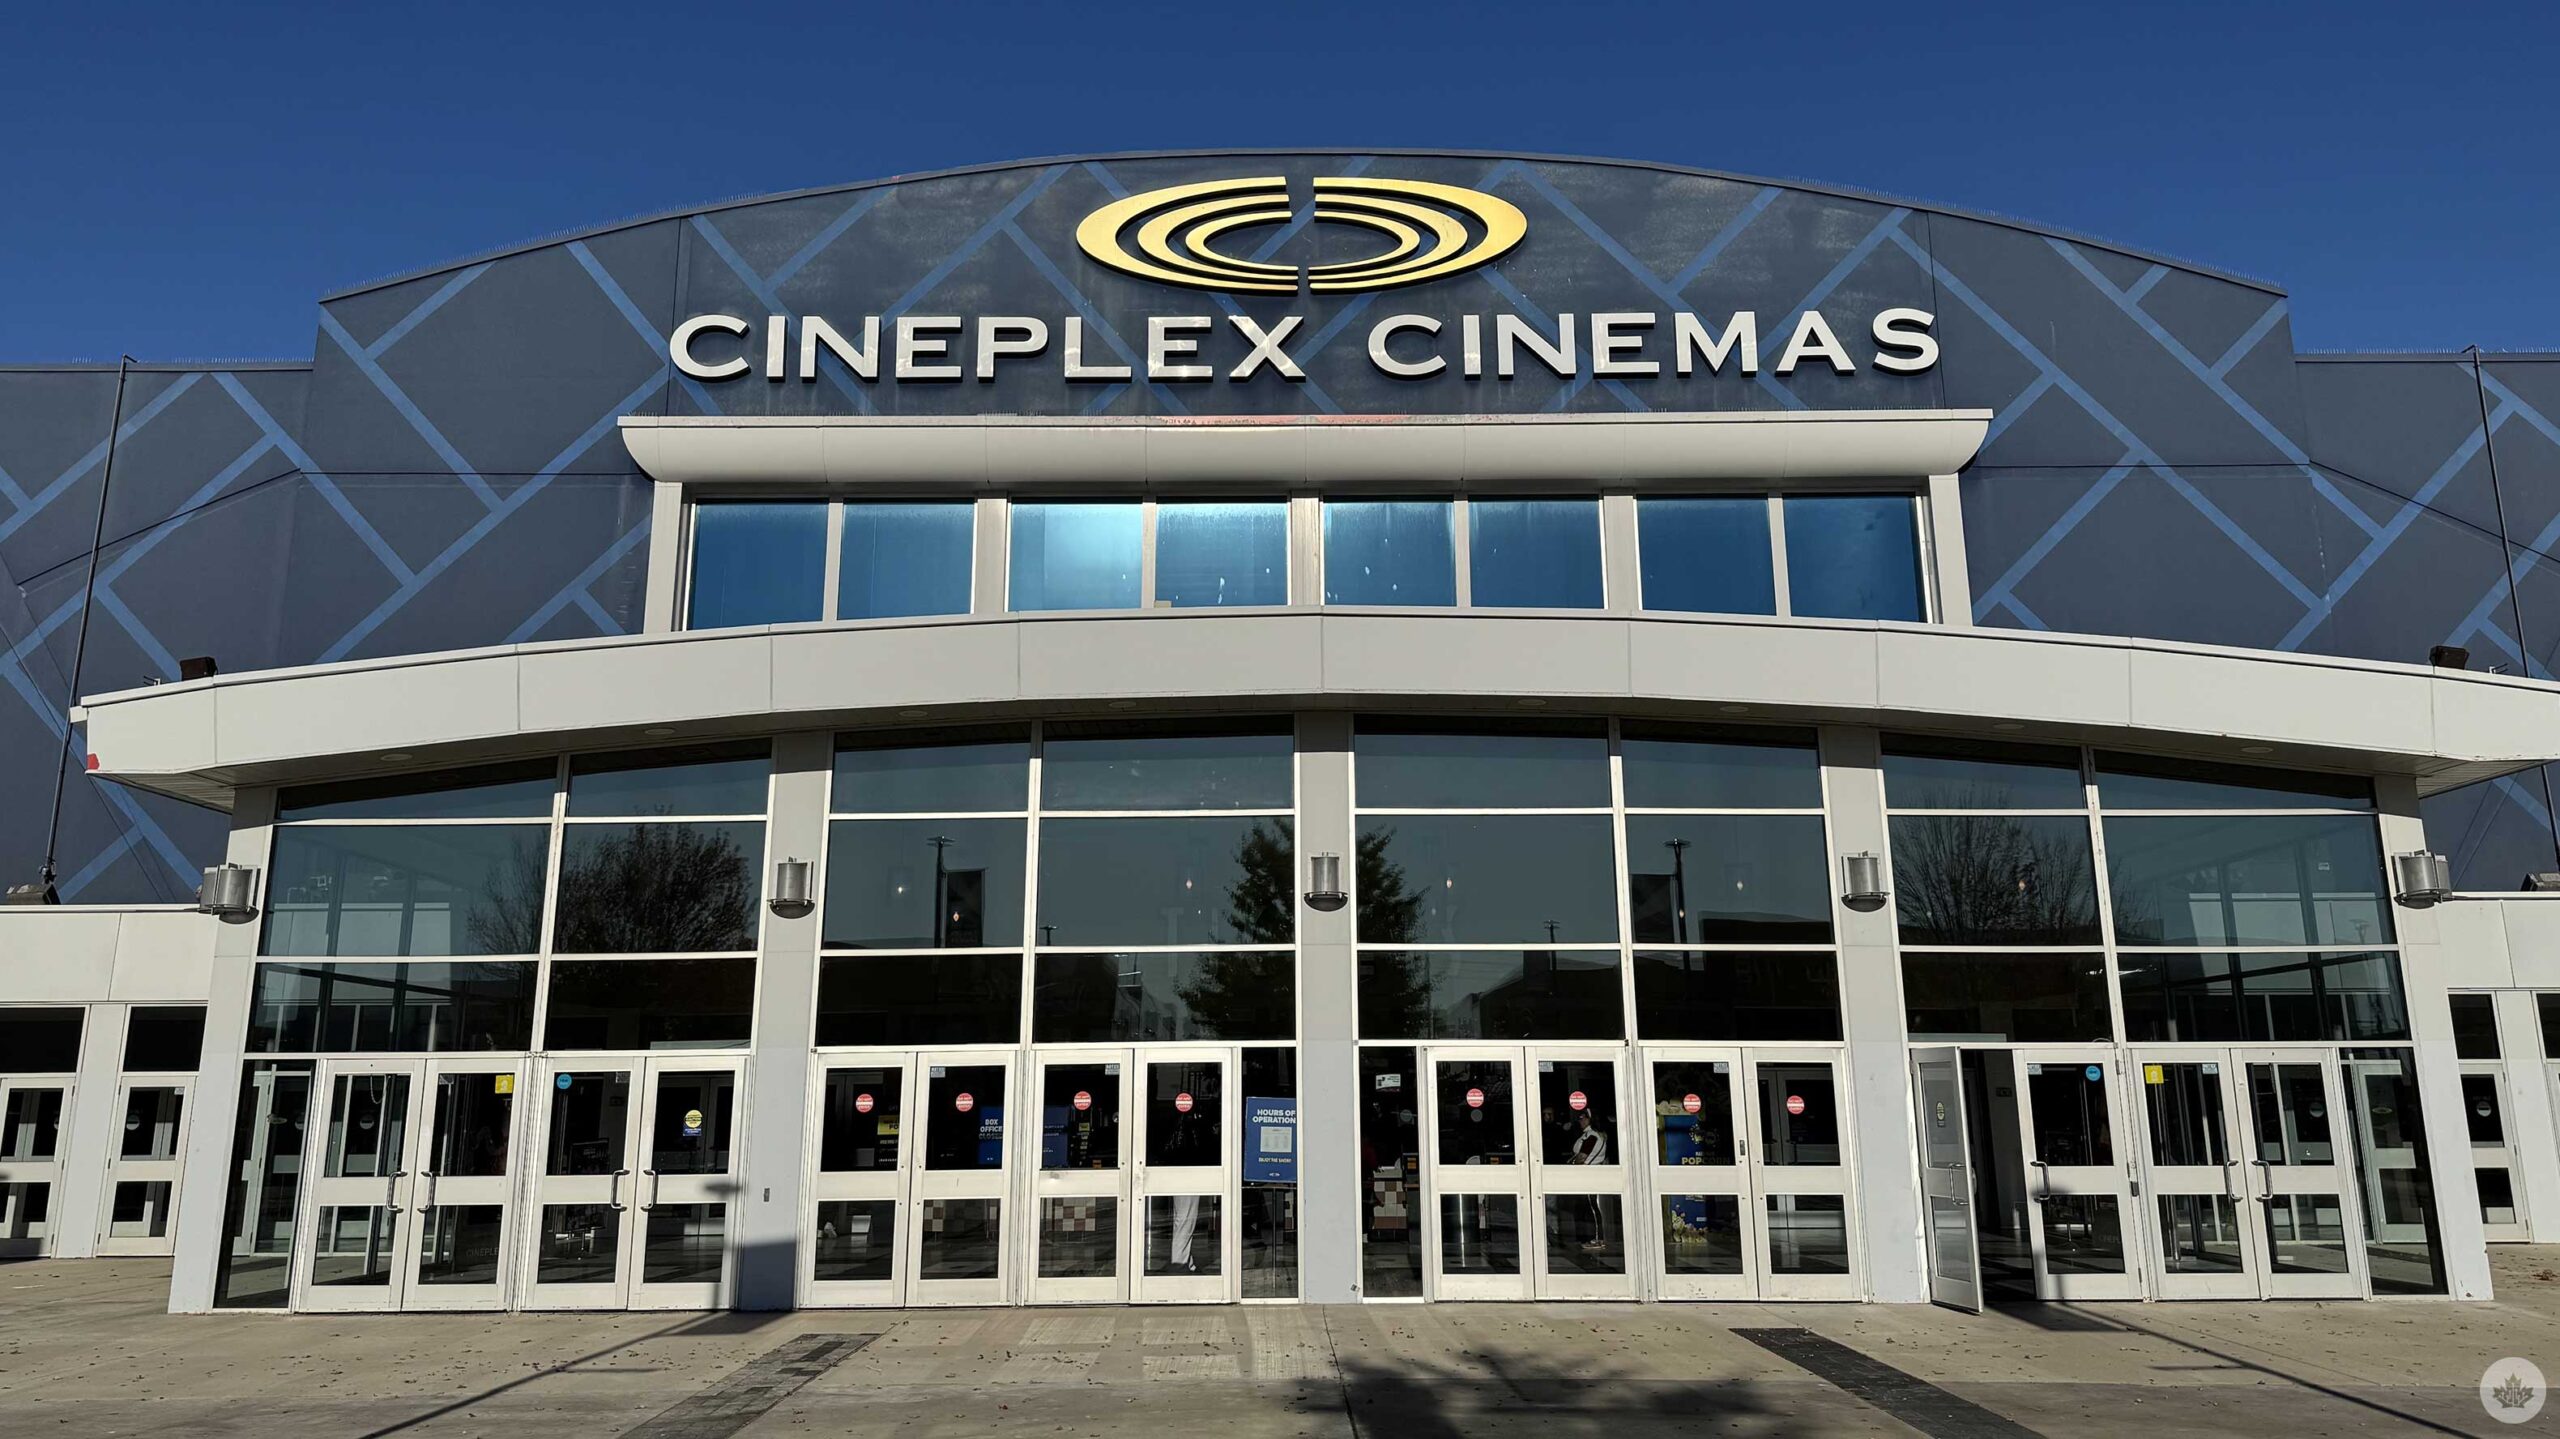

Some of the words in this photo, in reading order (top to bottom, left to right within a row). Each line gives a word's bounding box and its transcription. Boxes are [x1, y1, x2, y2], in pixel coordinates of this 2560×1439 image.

[670, 314, 1306, 382] CINEPLEX
[1367, 308, 1941, 380] CINEMAS
[1252, 1116, 1296, 1124] OPERATION
